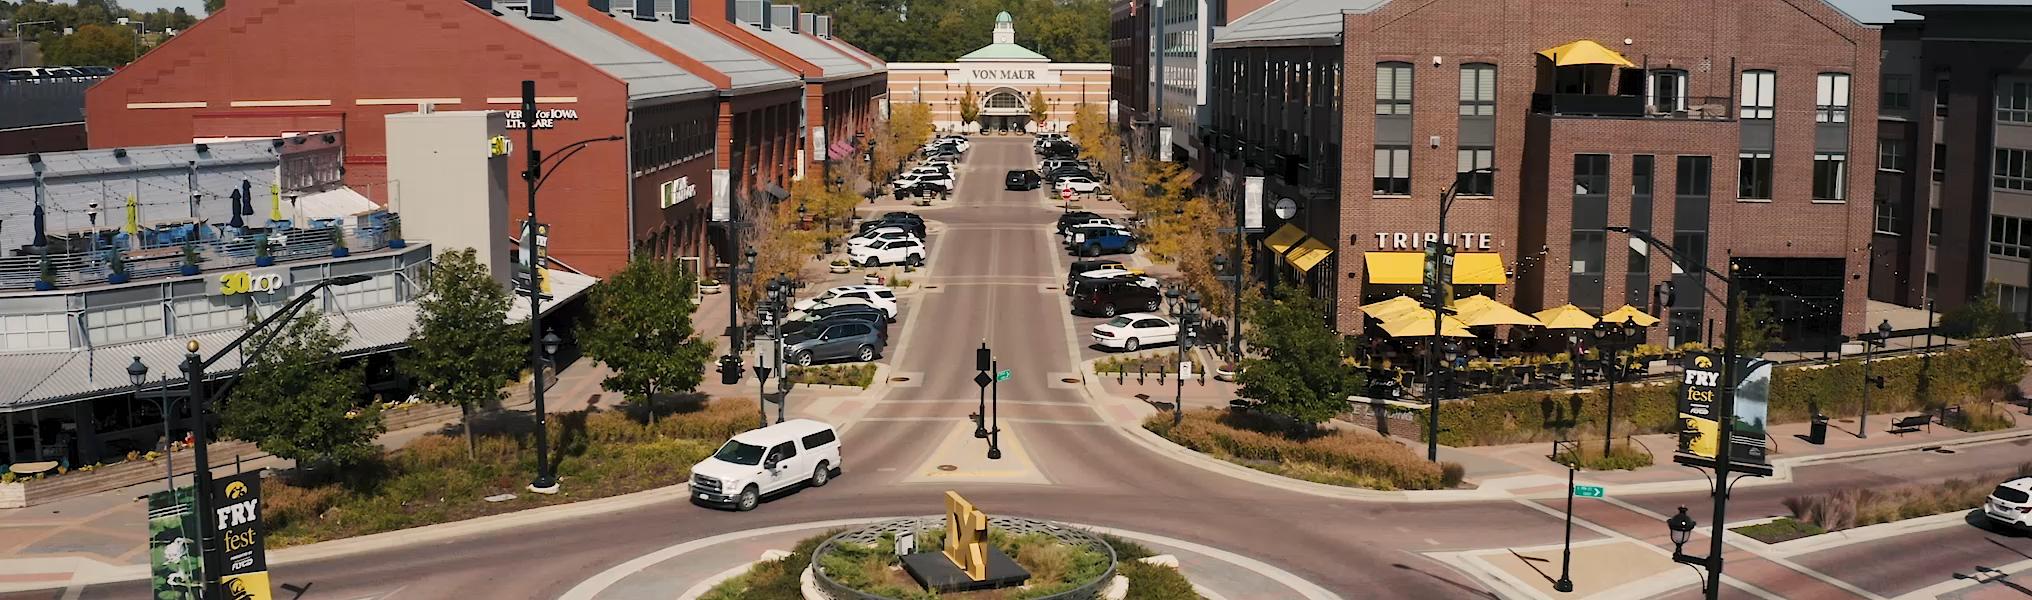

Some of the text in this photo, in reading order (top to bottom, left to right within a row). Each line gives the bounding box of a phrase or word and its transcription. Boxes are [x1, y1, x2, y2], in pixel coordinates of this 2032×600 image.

[972, 69, 1036, 80] VON MAUR
[551, 109, 578, 119] IOWA
[531, 119, 554, 128] ARE
[1375, 232, 1492, 249] TRIBUTE
[220, 271, 284, 295] 30hop
[1685, 369, 1719, 387] FRY
[1688, 386, 1714, 402] fest
[217, 499, 257, 530] FRY
[224, 528, 256, 553] fest
